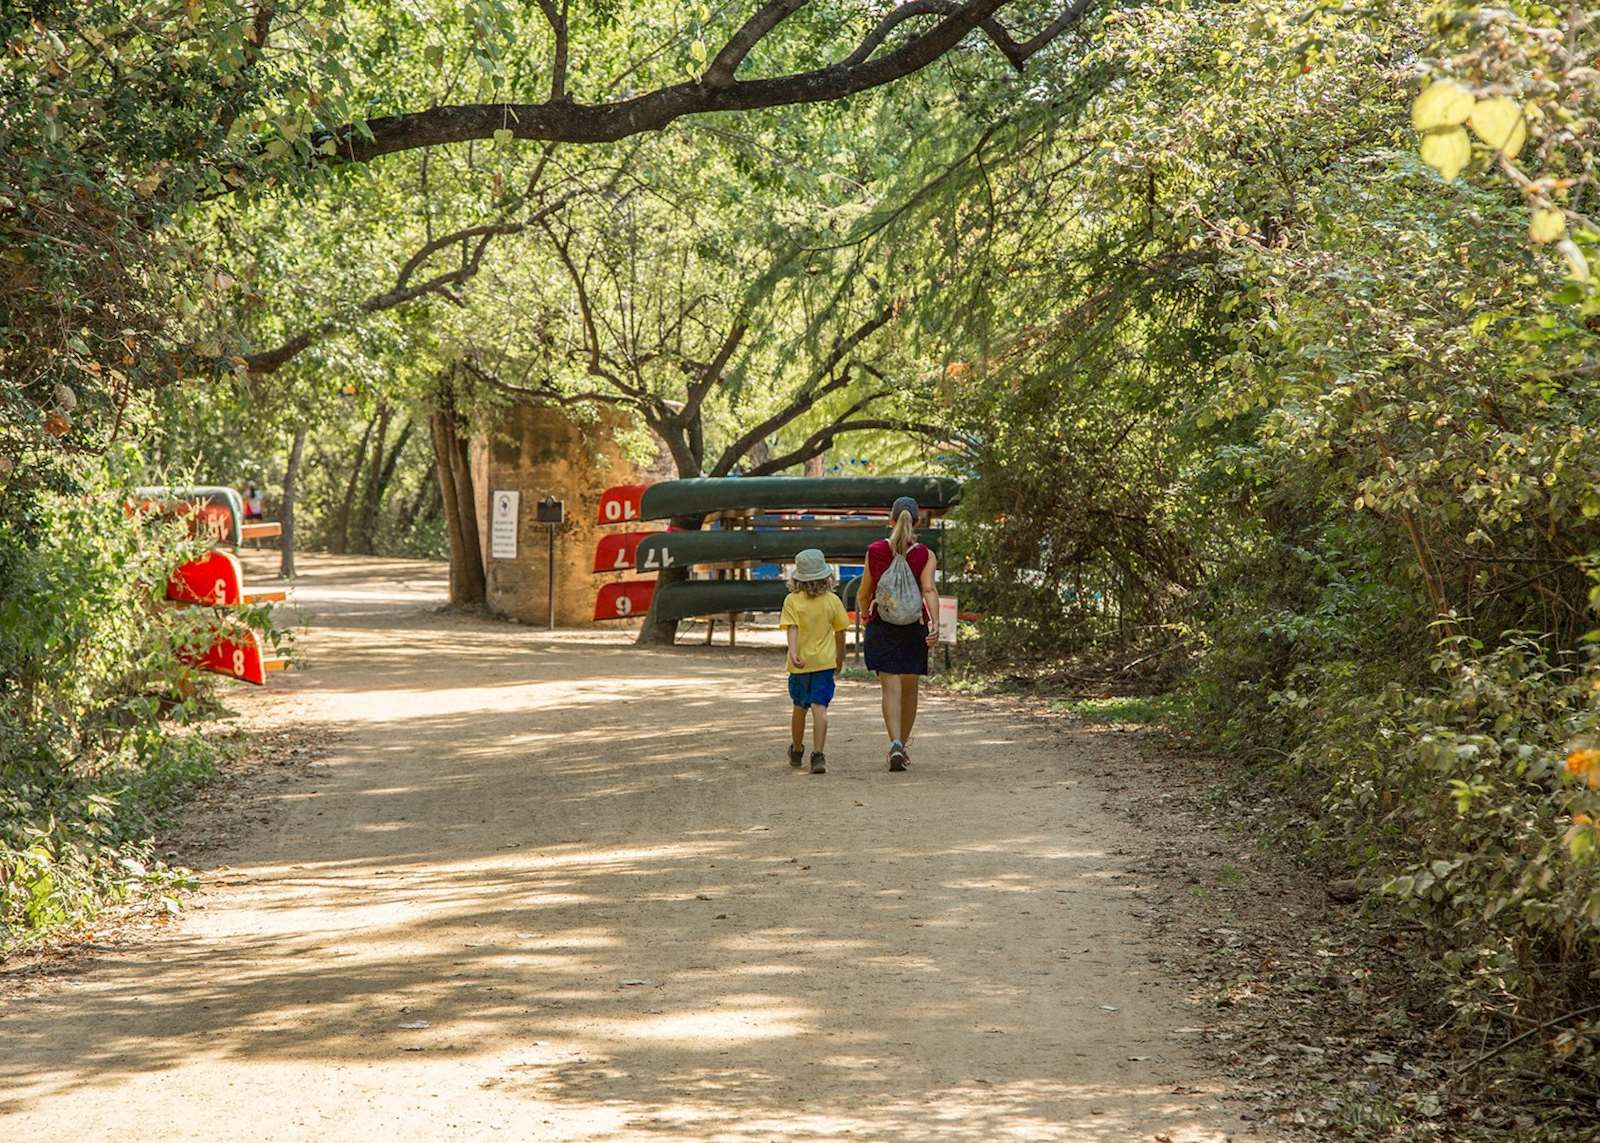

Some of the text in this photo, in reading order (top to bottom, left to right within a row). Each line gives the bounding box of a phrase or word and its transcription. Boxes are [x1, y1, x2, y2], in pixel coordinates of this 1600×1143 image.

[606, 501, 636, 520] 10
[614, 549, 629, 569] 7
[644, 548, 674, 569] 17
[214, 579, 226, 605] 5
[232, 650, 244, 676] 8
